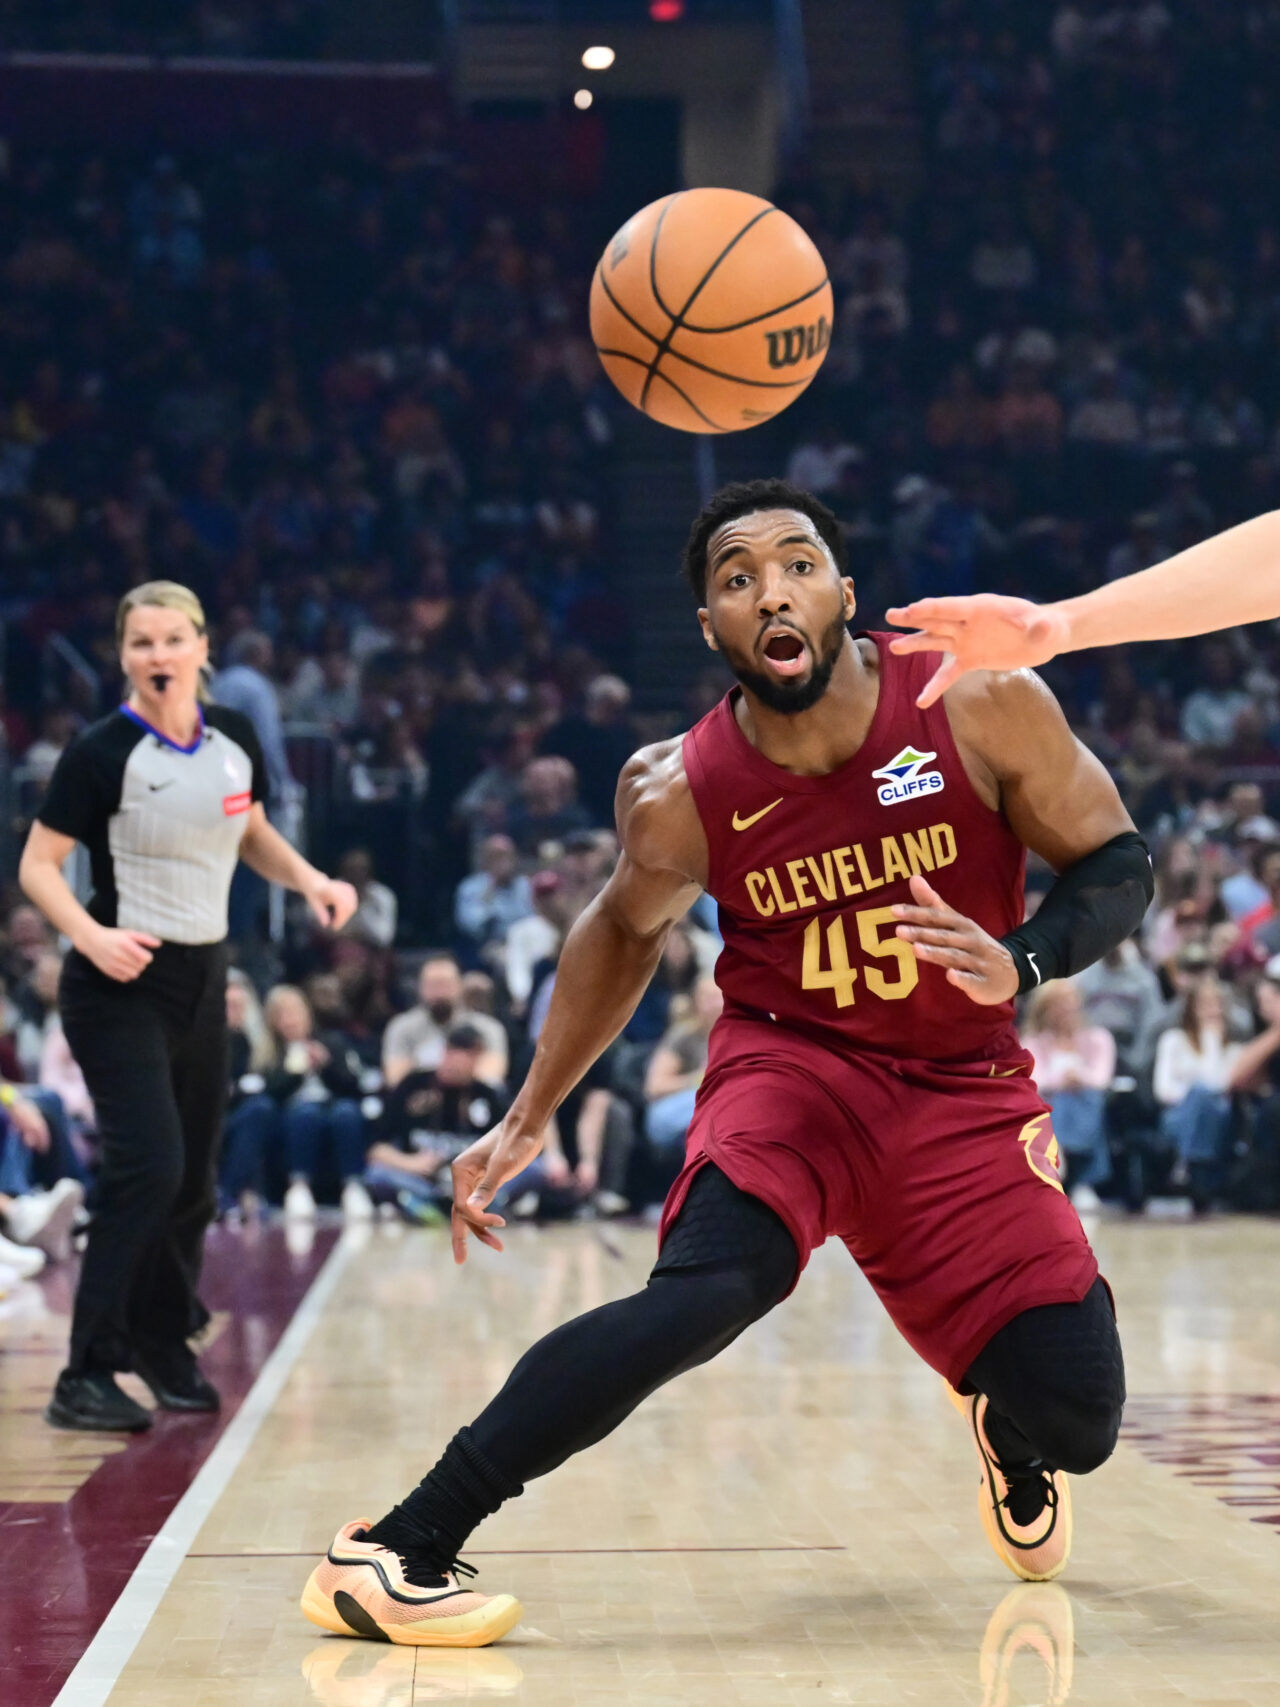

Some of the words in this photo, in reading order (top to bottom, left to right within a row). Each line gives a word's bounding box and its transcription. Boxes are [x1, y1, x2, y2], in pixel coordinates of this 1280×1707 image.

[765, 315, 832, 369] Wil
[881, 776, 941, 801] CLIFFS
[745, 822, 958, 917] CLEVELAND
[801, 903, 919, 1008] 45
